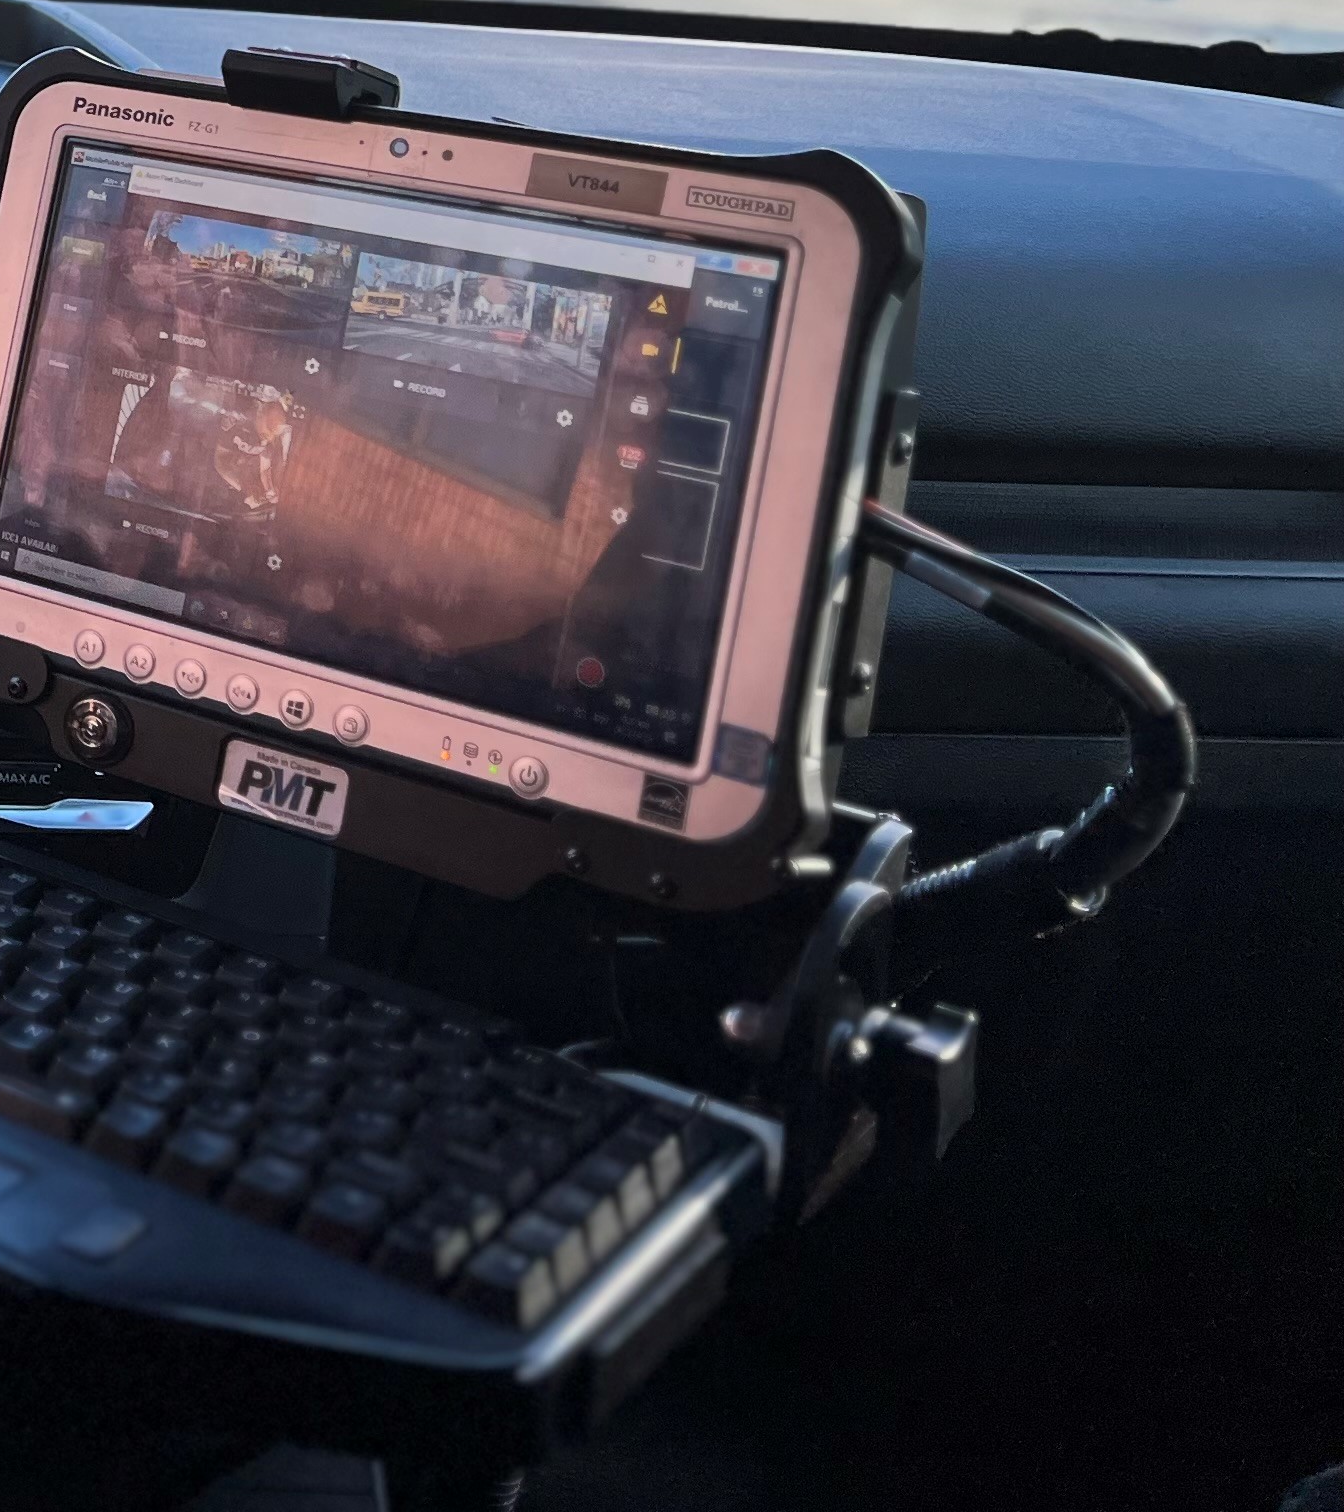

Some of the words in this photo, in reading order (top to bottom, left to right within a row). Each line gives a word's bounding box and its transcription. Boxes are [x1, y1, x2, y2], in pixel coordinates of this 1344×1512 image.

[73, 97, 174, 126] Panasonic
[188, 121, 219, 134] FZ-G1
[568, 172, 619, 194] VT844
[692, 191, 789, 217] TOUGHPAD
[172, 333, 206, 348] RECORD
[112, 367, 149, 383] INTERIOR
[407, 382, 446, 398] RECORD
[81, 641, 97, 654] A1
[130, 656, 148, 670] A2
[290, 761, 321, 776] Canada
[28, 774, 51, 786] A/C
[236, 759, 337, 817] PMT
